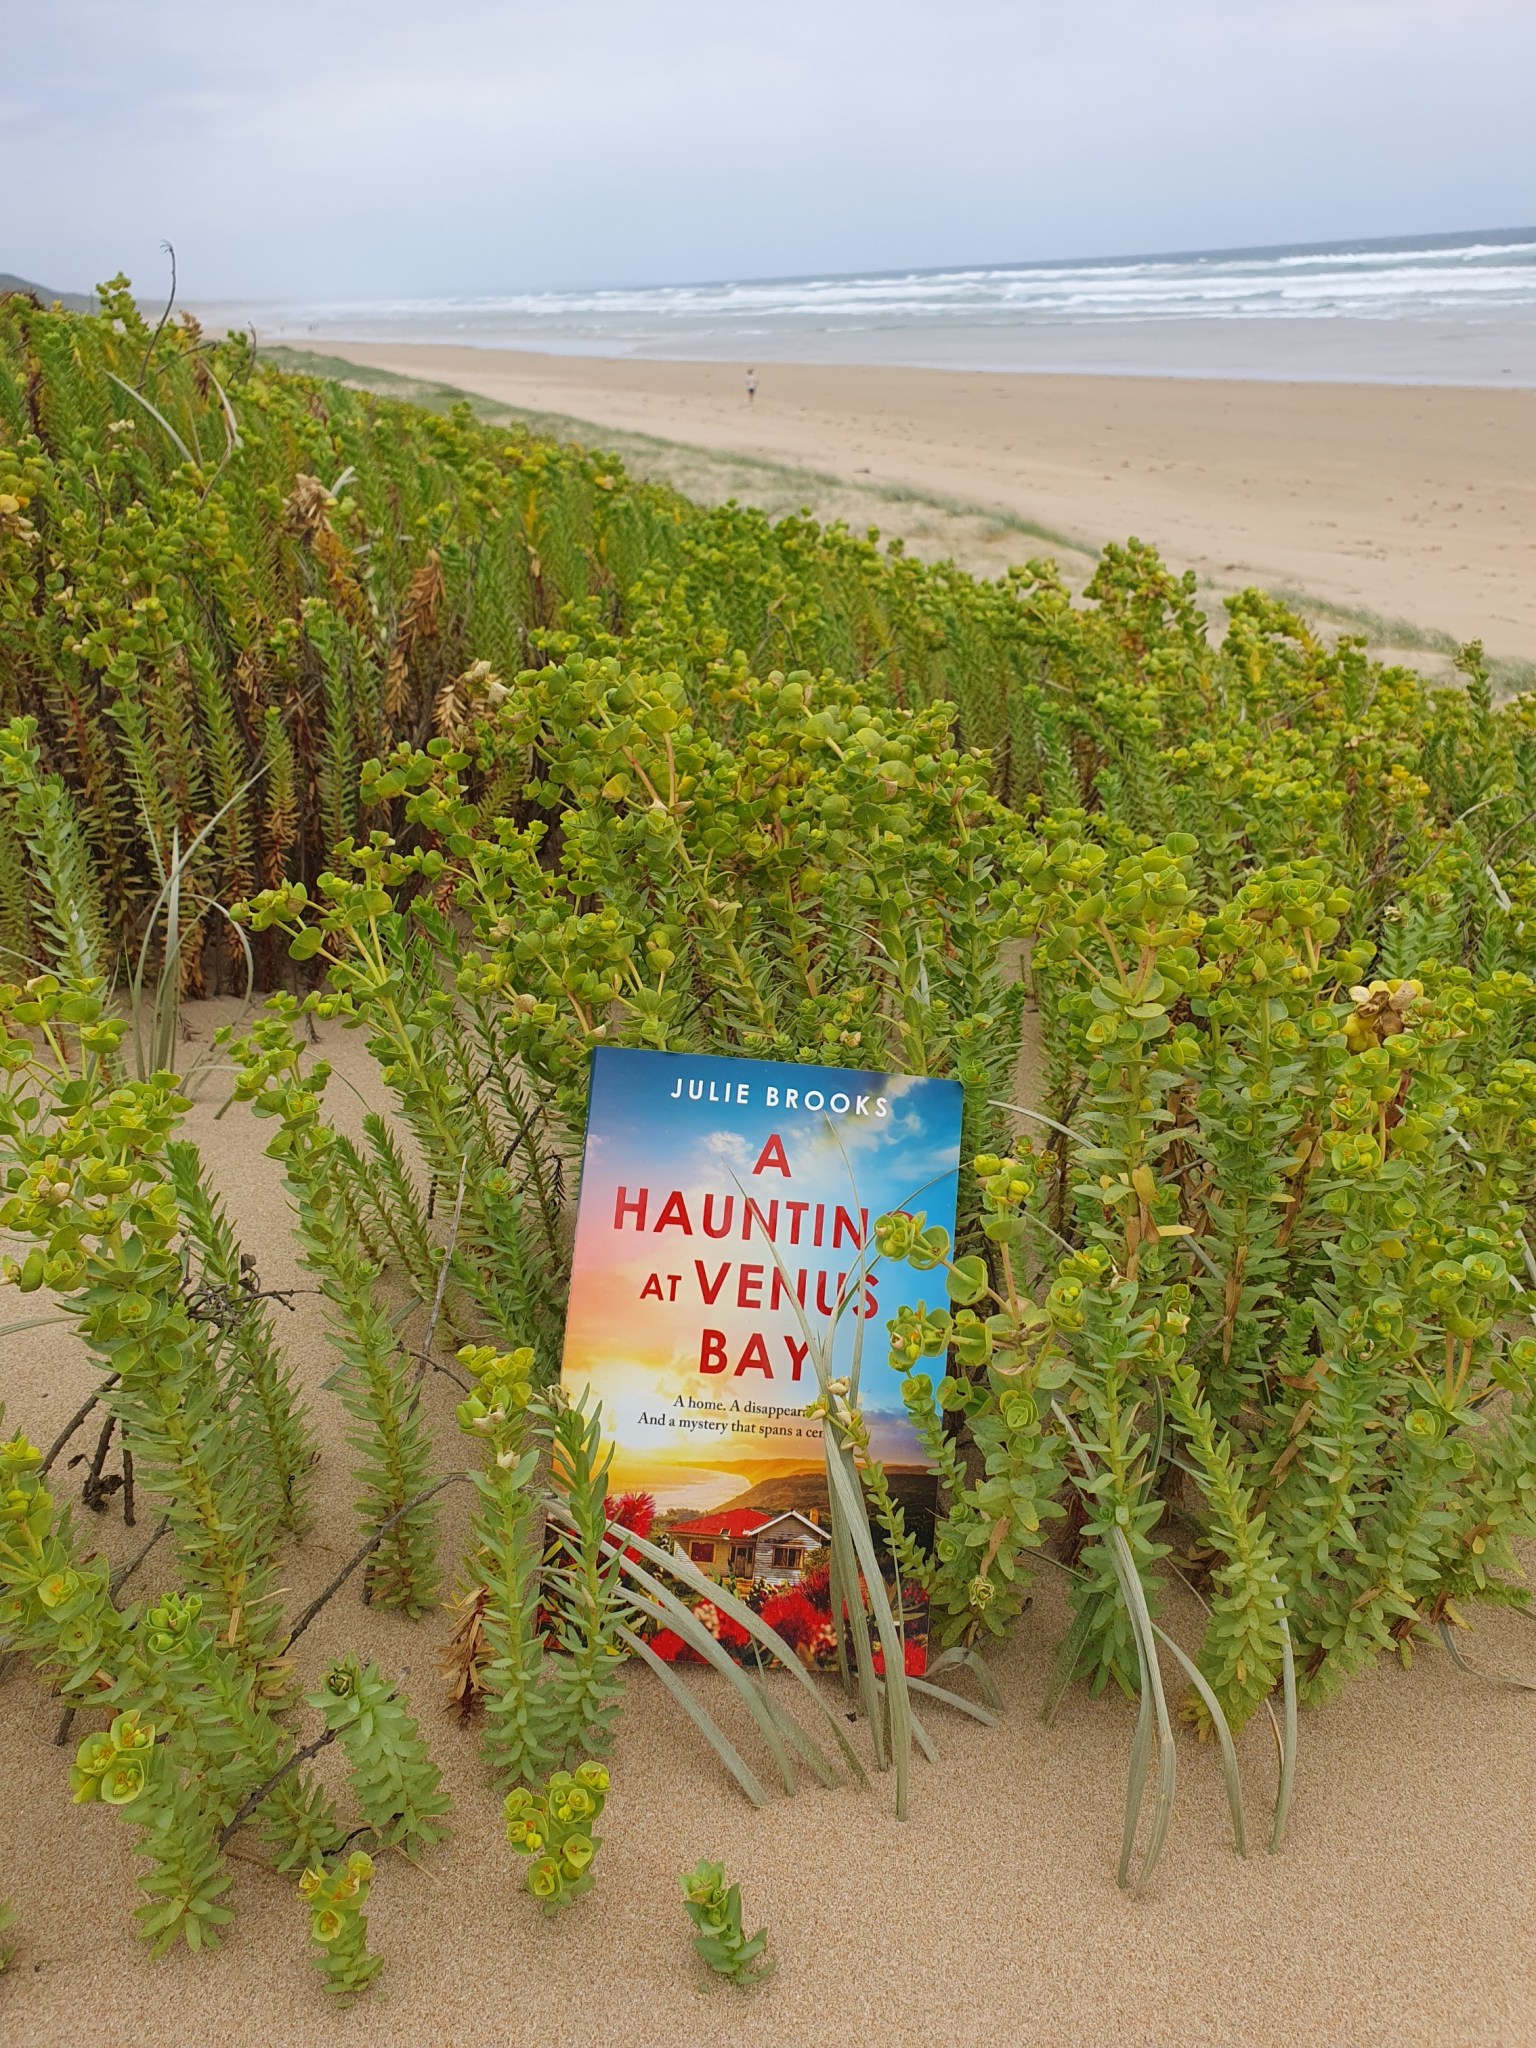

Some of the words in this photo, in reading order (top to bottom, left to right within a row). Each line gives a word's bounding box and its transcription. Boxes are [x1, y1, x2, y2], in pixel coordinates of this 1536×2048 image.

[670, 1078, 749, 1104] JULIE
[766, 1087, 888, 1118] BROOKS
[752, 1133, 791, 1178] A
[613, 1186, 914, 1252] HAUNTIN
[639, 1273, 682, 1302] AT
[694, 1259, 880, 1320] VENUS
[699, 1328, 809, 1381] BAY
[637, 1412, 665, 1426] And
[668, 1418, 675, 1428] a
[679, 1419, 728, 1435] mystery
[731, 1420, 755, 1434] that
[759, 1425, 793, 1439] spans
[796, 1427, 802, 1437] a
[673, 1394, 684, 1408] A
[688, 1396, 726, 1412] home.
[729, 1400, 741, 1413] A
